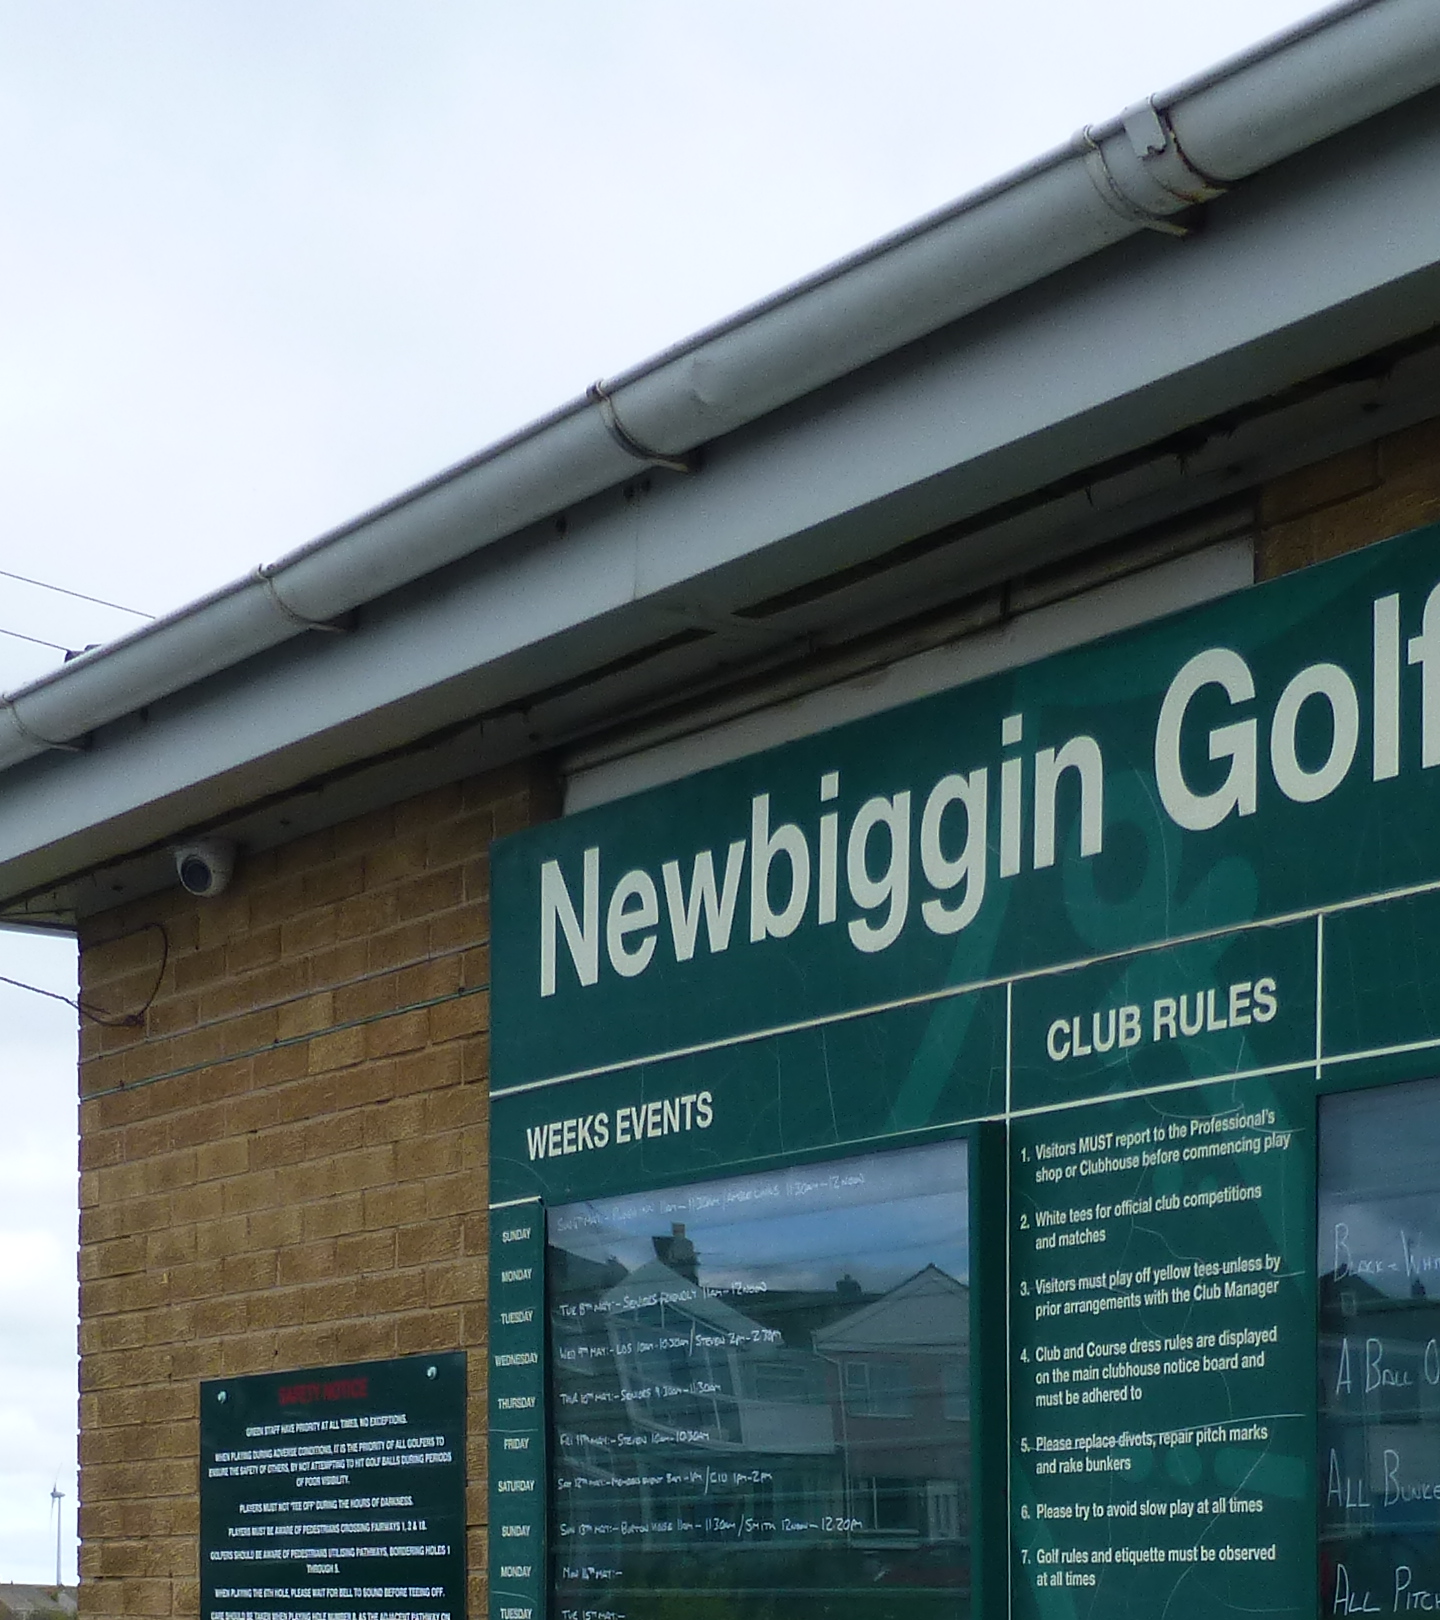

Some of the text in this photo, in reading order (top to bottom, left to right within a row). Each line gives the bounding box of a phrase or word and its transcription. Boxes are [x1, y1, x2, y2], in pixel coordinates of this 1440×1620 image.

[540, 712, 1102, 996] Newbiggin
[1048, 980, 1276, 1060] CLUB RULES
[526, 1091, 714, 1162] WEEKS EVENTS
[1021, 1110, 1275, 1162] 1. Visitors MUST report to the Professional's
[1036, 1132, 1290, 1182] shop or Clubhouse before commencing play
[1020, 1185, 1261, 1230] 2. White tees for official club competitions
[502, 1229, 531, 1242] SUNDAY
[1036, 1229, 1106, 1250] and matches
[501, 1269, 532, 1282] MONDAY
[1020, 1254, 1280, 1296] 3. Visitors must play off yellow tees unless by
[1036, 1279, 1279, 1320] prior arrangements with the Club Manager
[501, 1311, 533, 1324] TUESDAY
[495, 1353, 538, 1366] WEDNESDAY
[498, 1397, 535, 1409] THURSDAY
[504, 1439, 529, 1449] FRIDAY
[498, 1480, 535, 1492] SATURDAY
[1021, 1498, 1262, 1520] 6. Please try to avoid slow play at all times
